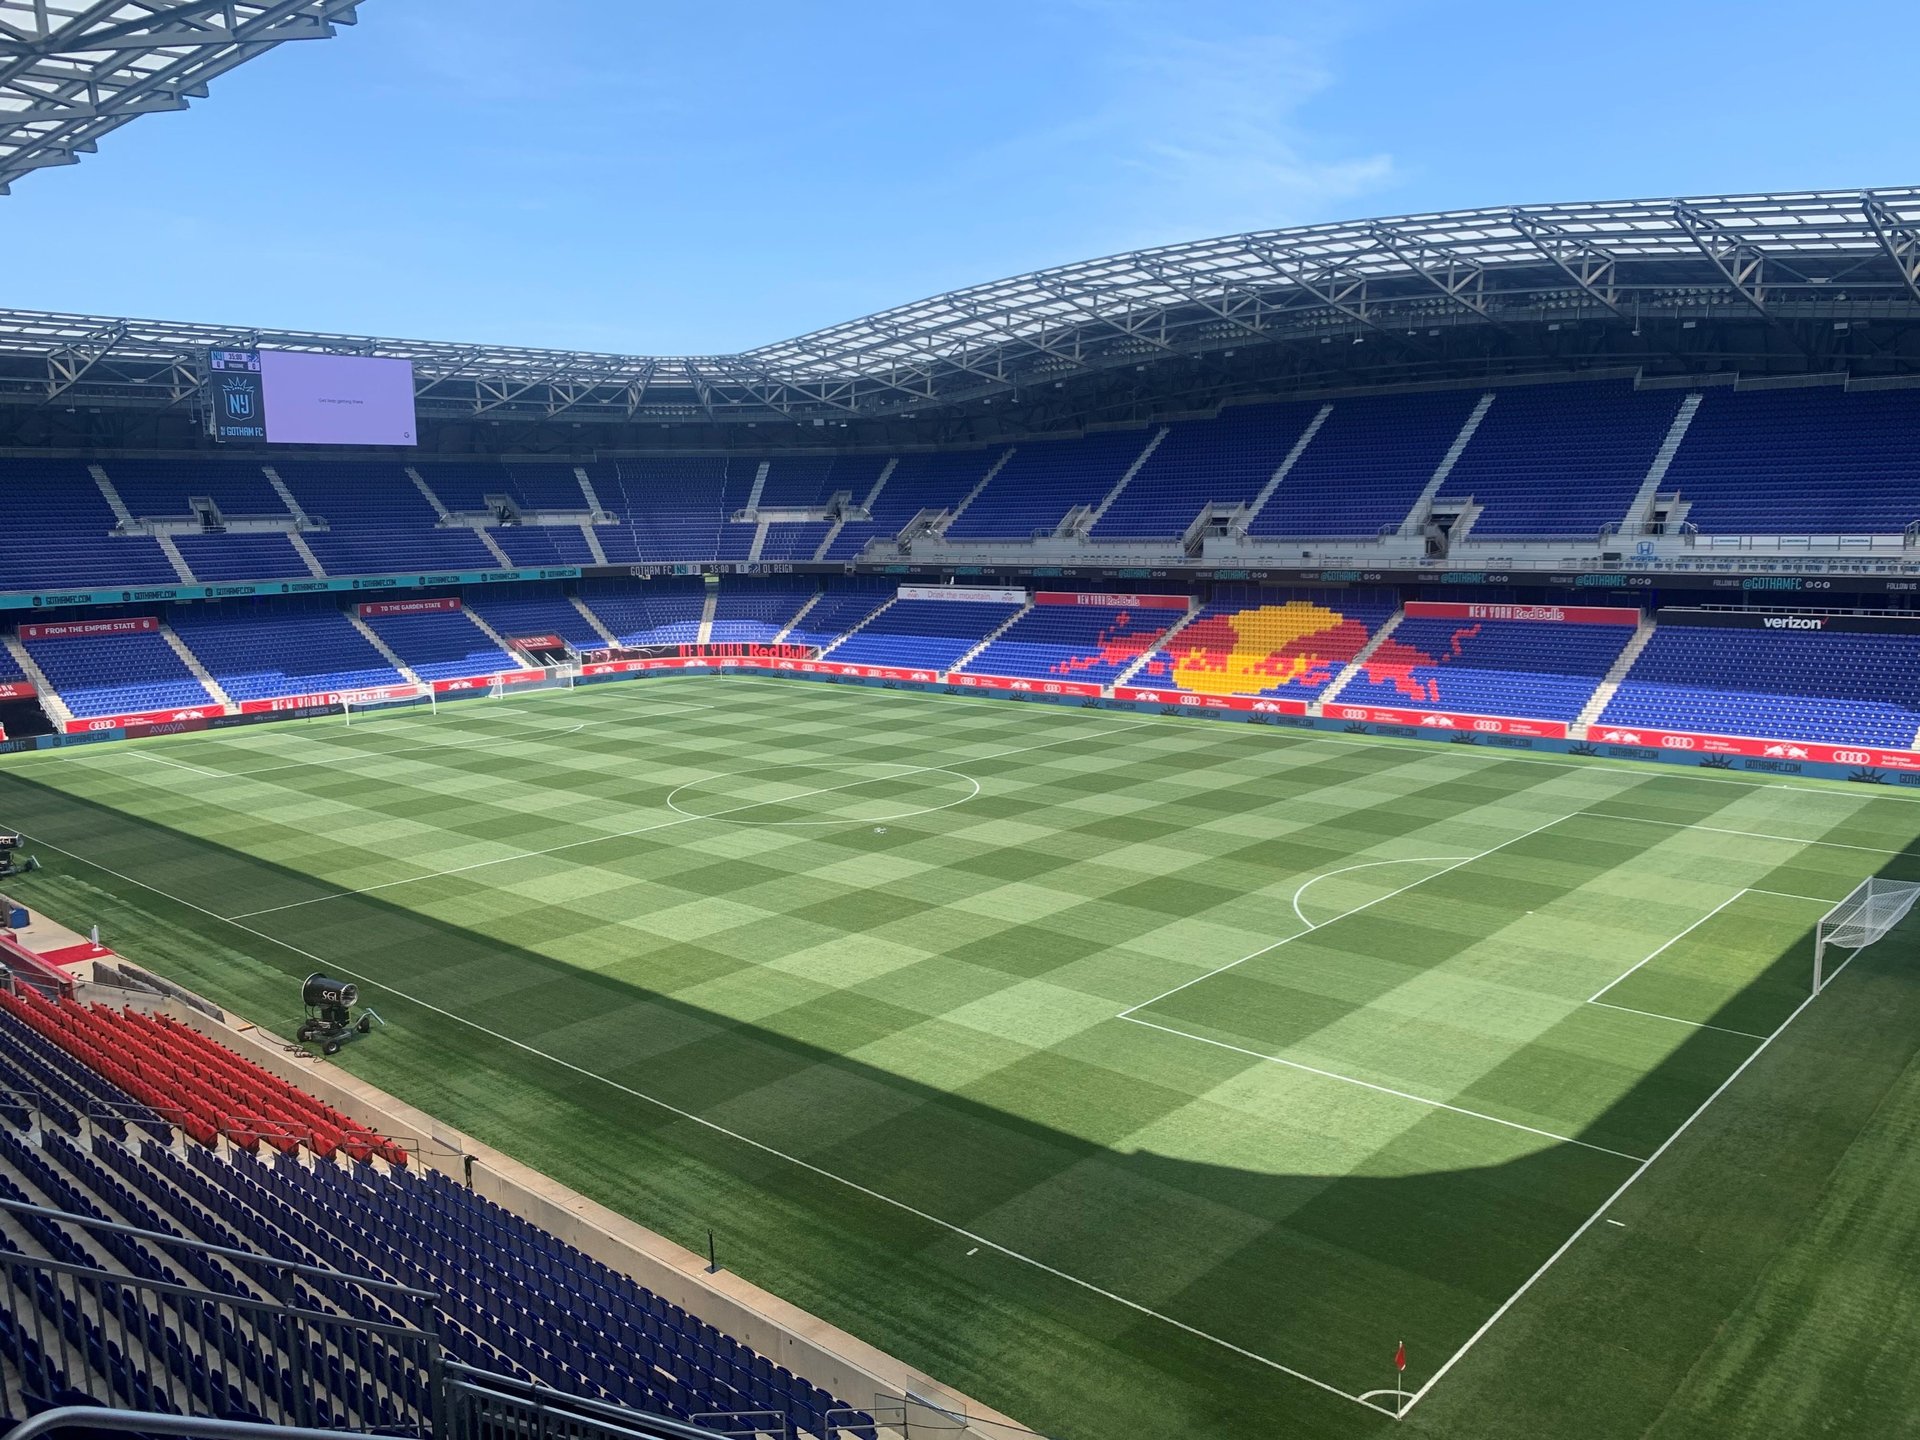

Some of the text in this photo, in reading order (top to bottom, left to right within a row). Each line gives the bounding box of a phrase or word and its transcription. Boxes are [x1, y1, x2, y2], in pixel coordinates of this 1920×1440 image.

[226, 426, 254, 436] GOTHAM
[255, 427, 264, 437] FC
[630, 565, 672, 576] GOTHAM FC
[709, 565, 730, 573] 35:00
[763, 564, 793, 573] OL REIGN
[1441, 573, 1487, 583] @GOTHAMFC
[1575, 575, 1628, 587] @GOTHAMFC
[1742, 577, 1803, 590] @GOTHAMFC
[1886, 582, 1908, 590] FOLLOW
[46, 594, 92, 605] GOTHAMFC.COM
[134, 590, 177, 600] GOTHAMFC.COM
[927, 590, 993, 600] Drink the mountain.
[1077, 595, 1090, 604] NEW
[401, 603, 424, 611] GARDEN
[1469, 606, 1565, 621] NEW YORK Red Bulls
[1763, 616, 1821, 629] verizon
[45, 622, 136, 635] FROM THE EMPIRE STATE
[749, 643, 779, 658] Red
[150, 723, 185, 734] AVAYA
[1609, 746, 1659, 759] GOTHAMFC.COM
[1744, 759, 1802, 773] GOTHAMFC.COM
[321, 990, 340, 1002] SGL
